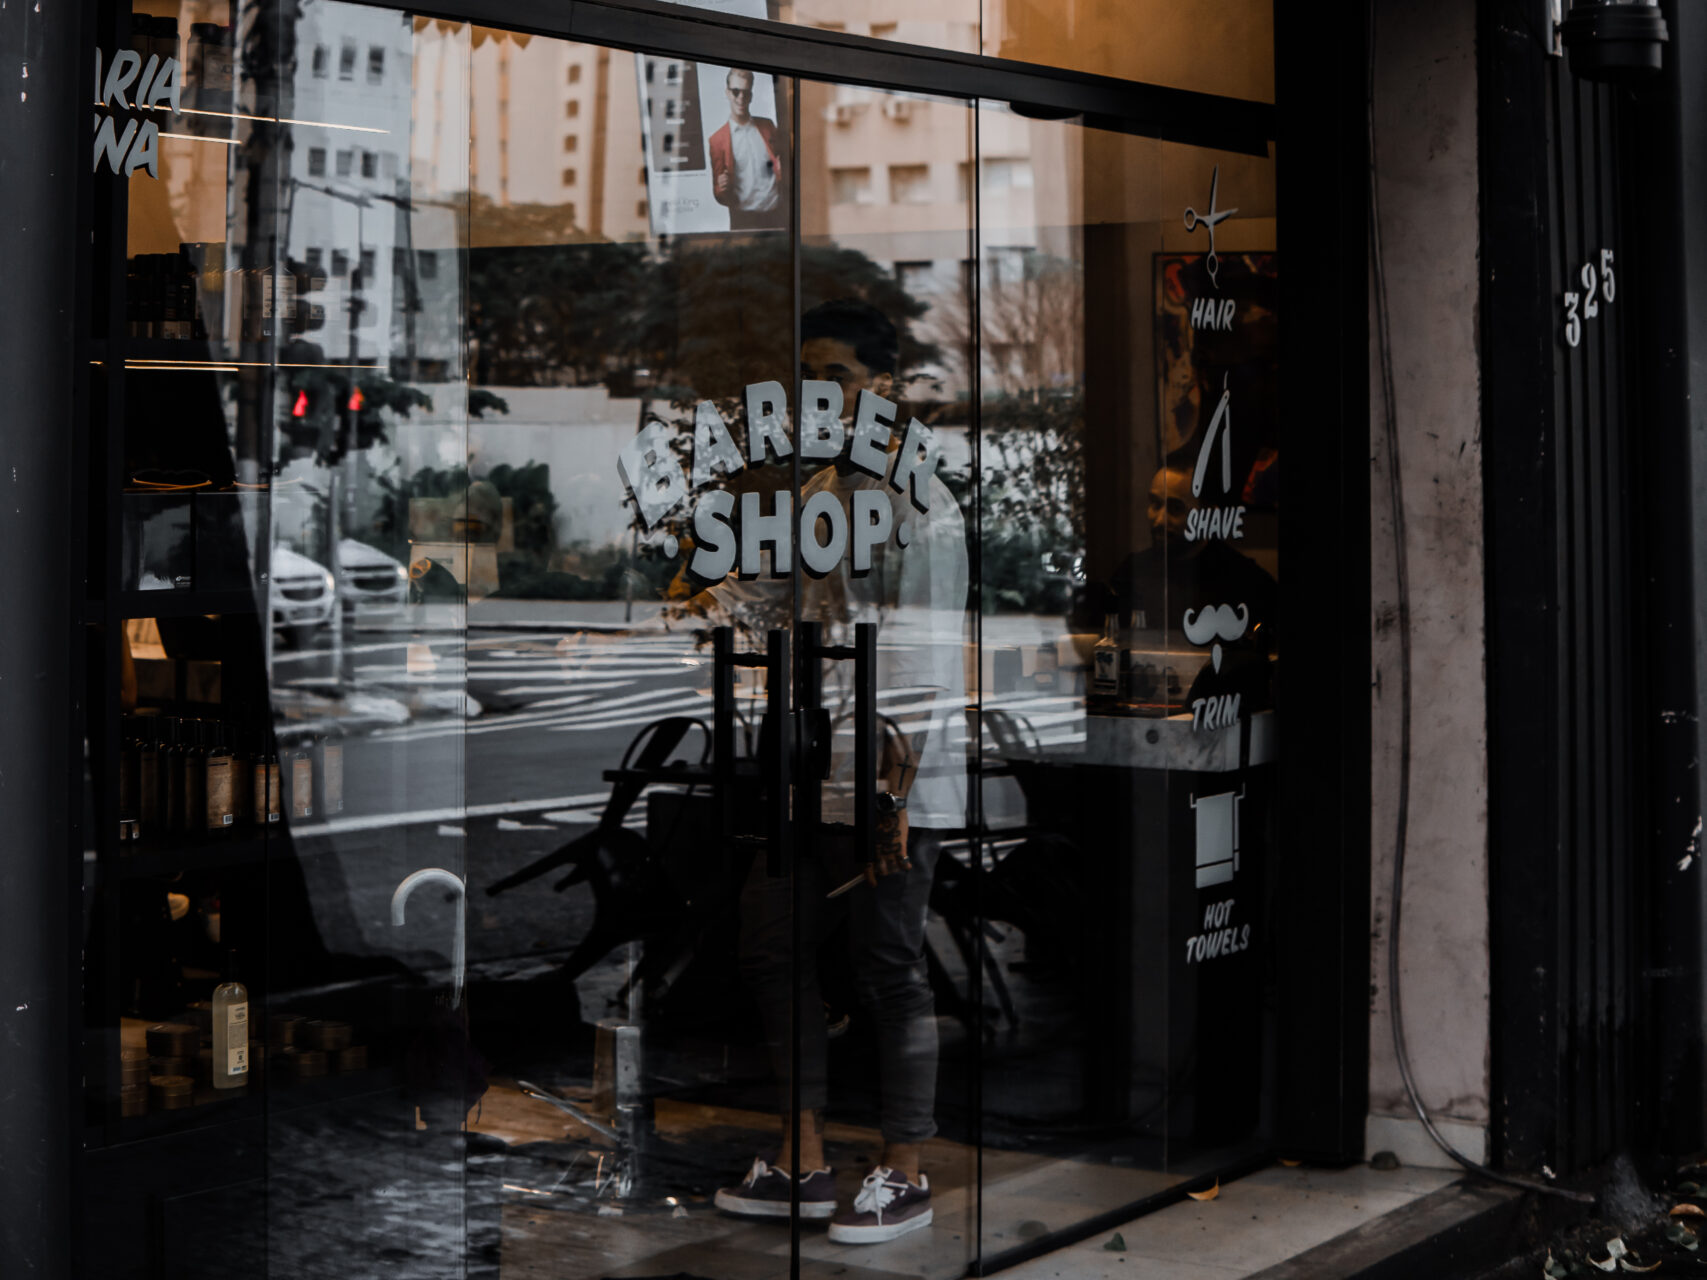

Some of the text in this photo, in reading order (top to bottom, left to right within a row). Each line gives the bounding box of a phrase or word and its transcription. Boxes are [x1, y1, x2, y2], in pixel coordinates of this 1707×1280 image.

[95, 46, 182, 116] RIA
[94, 113, 159, 180] NA
[1190, 297, 1236, 332] HAIR
[1564, 248, 1616, 348] 325
[617, 379, 944, 539] BARBER
[687, 489, 894, 586] SHOP
[1184, 506, 1246, 542] SHAVE
[1191, 692, 1242, 732] TRIM
[1203, 898, 1236, 930] HOT
[1186, 923, 1251, 965] TOWELS
